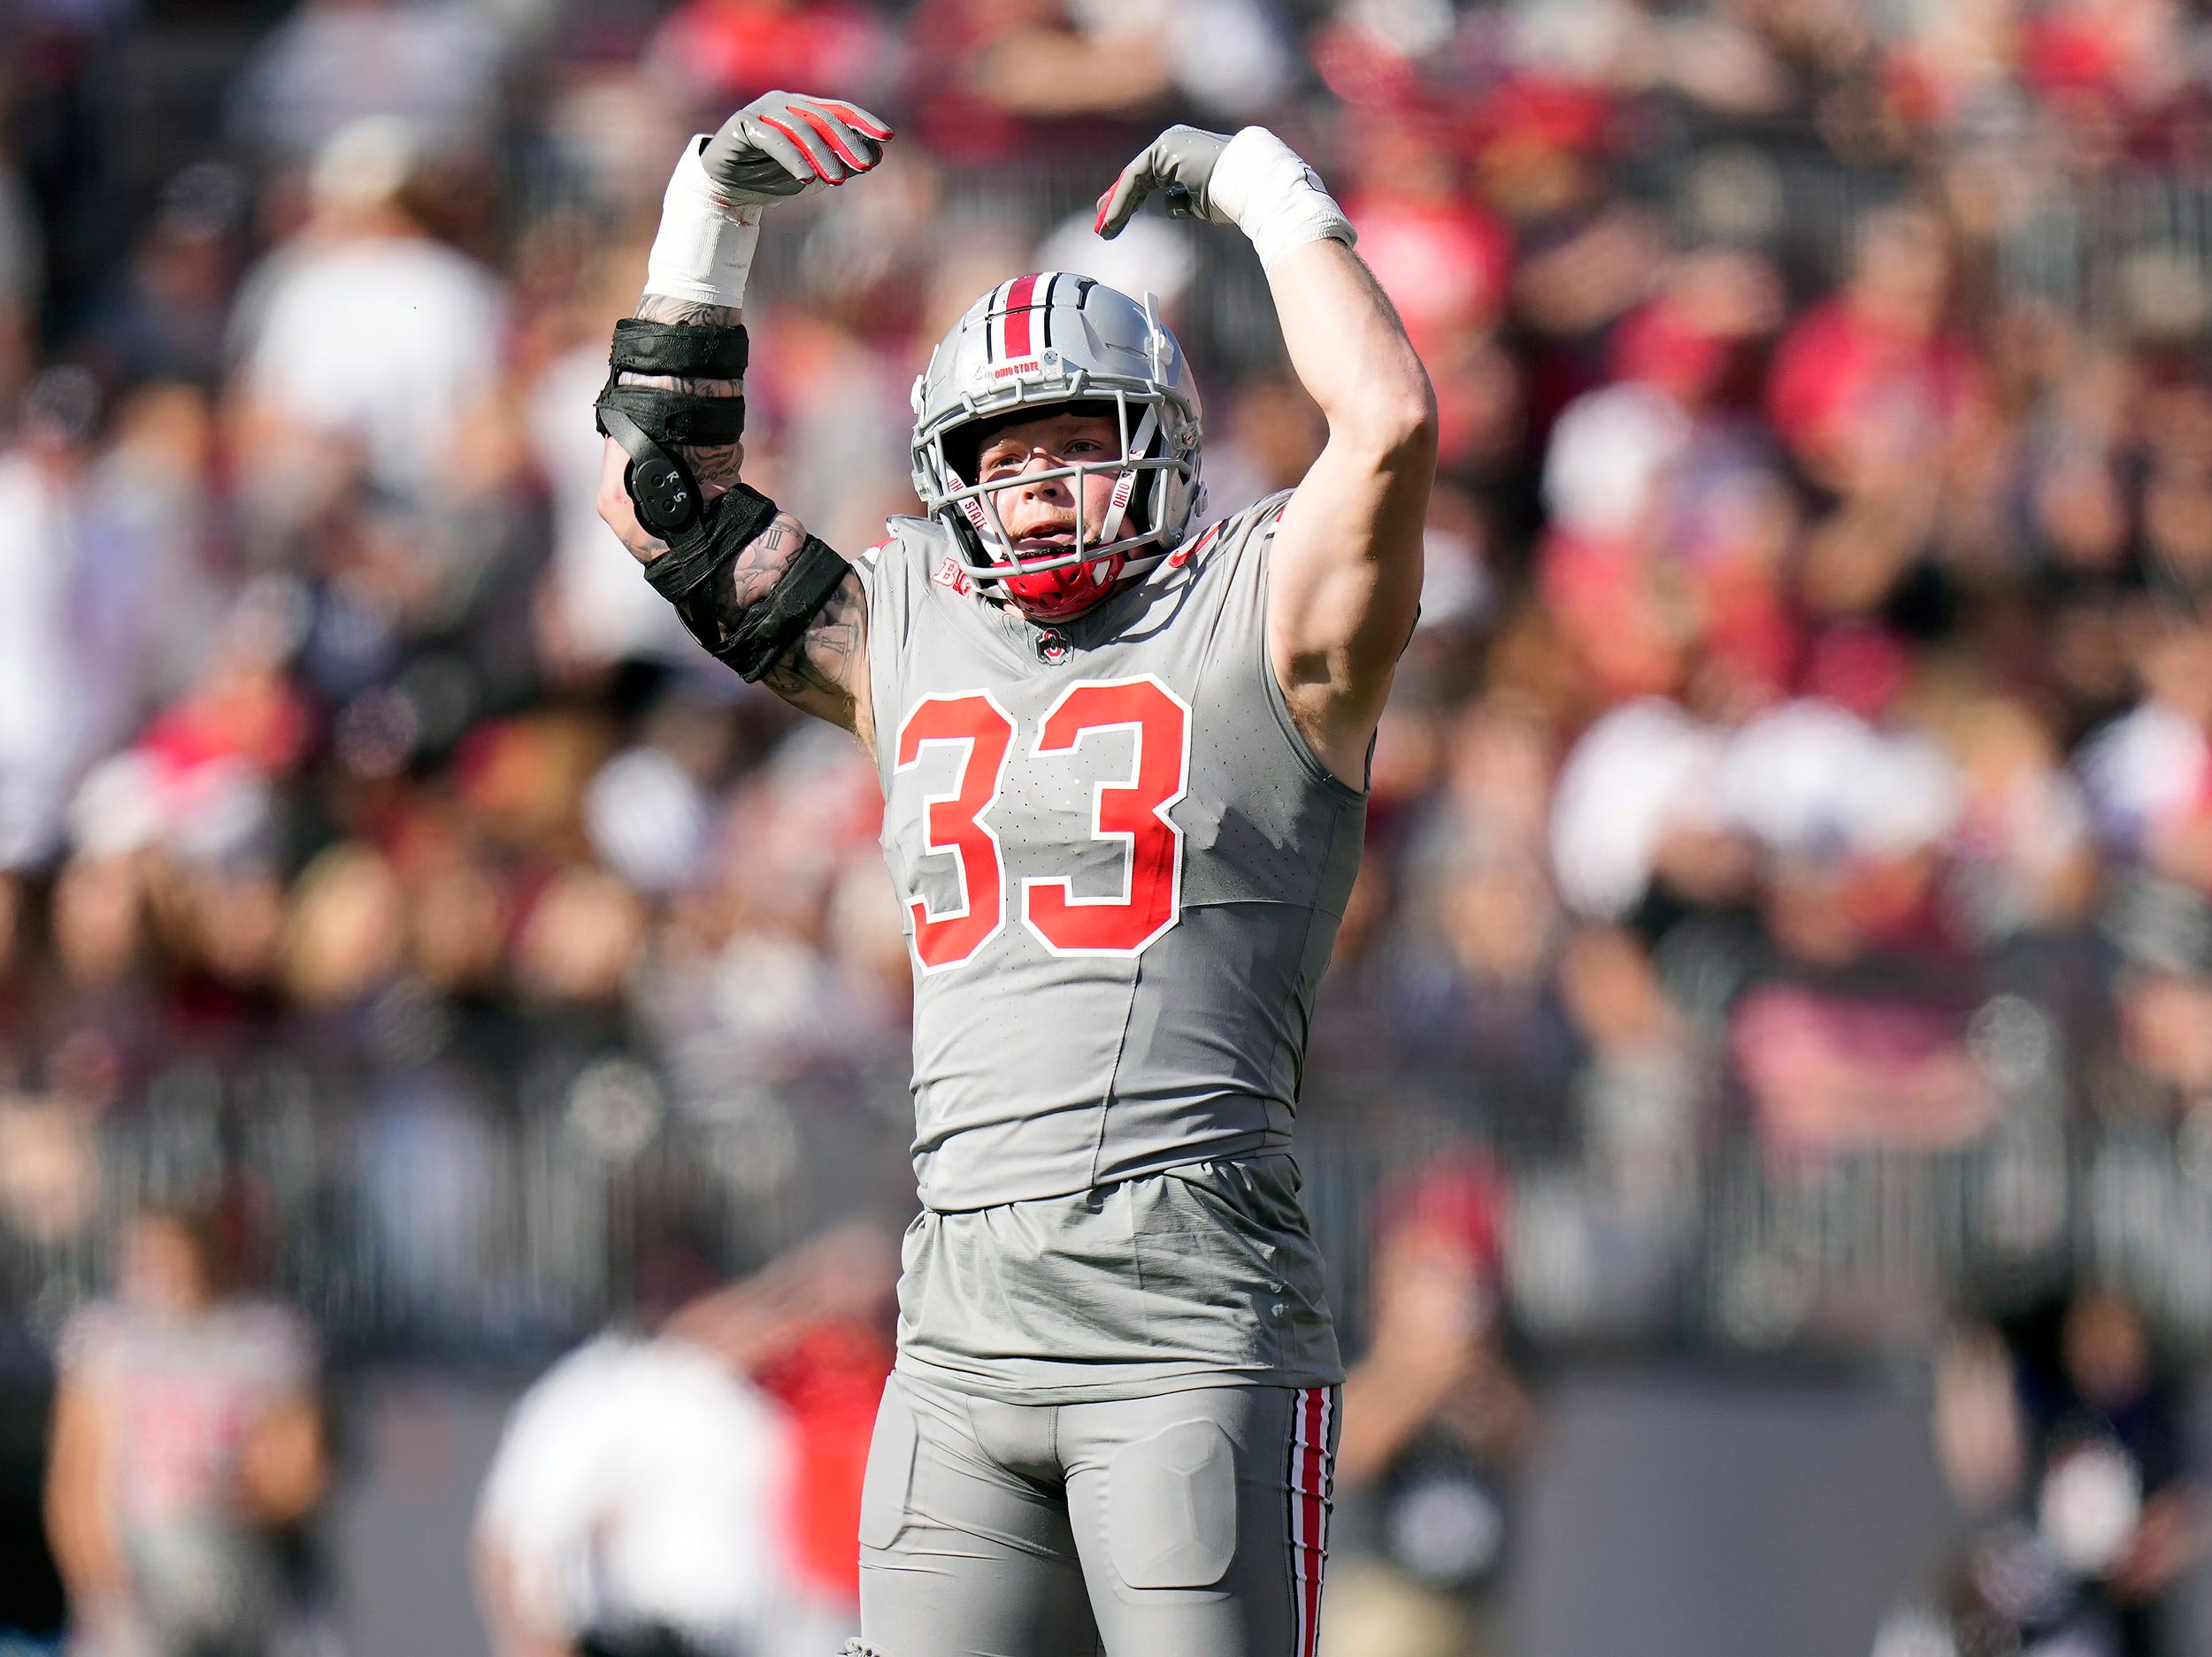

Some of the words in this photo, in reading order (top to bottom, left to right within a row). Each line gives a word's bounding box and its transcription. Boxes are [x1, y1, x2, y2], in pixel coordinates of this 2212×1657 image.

[995, 366, 1013, 379] OHIO
[1013, 361, 1040, 374] STATE
[665, 471, 680, 484] R
[672, 492, 687, 502] S
[1112, 482, 1131, 509] OHIO
[964, 501, 988, 532] STATE
[894, 672, 1193, 977] 33
